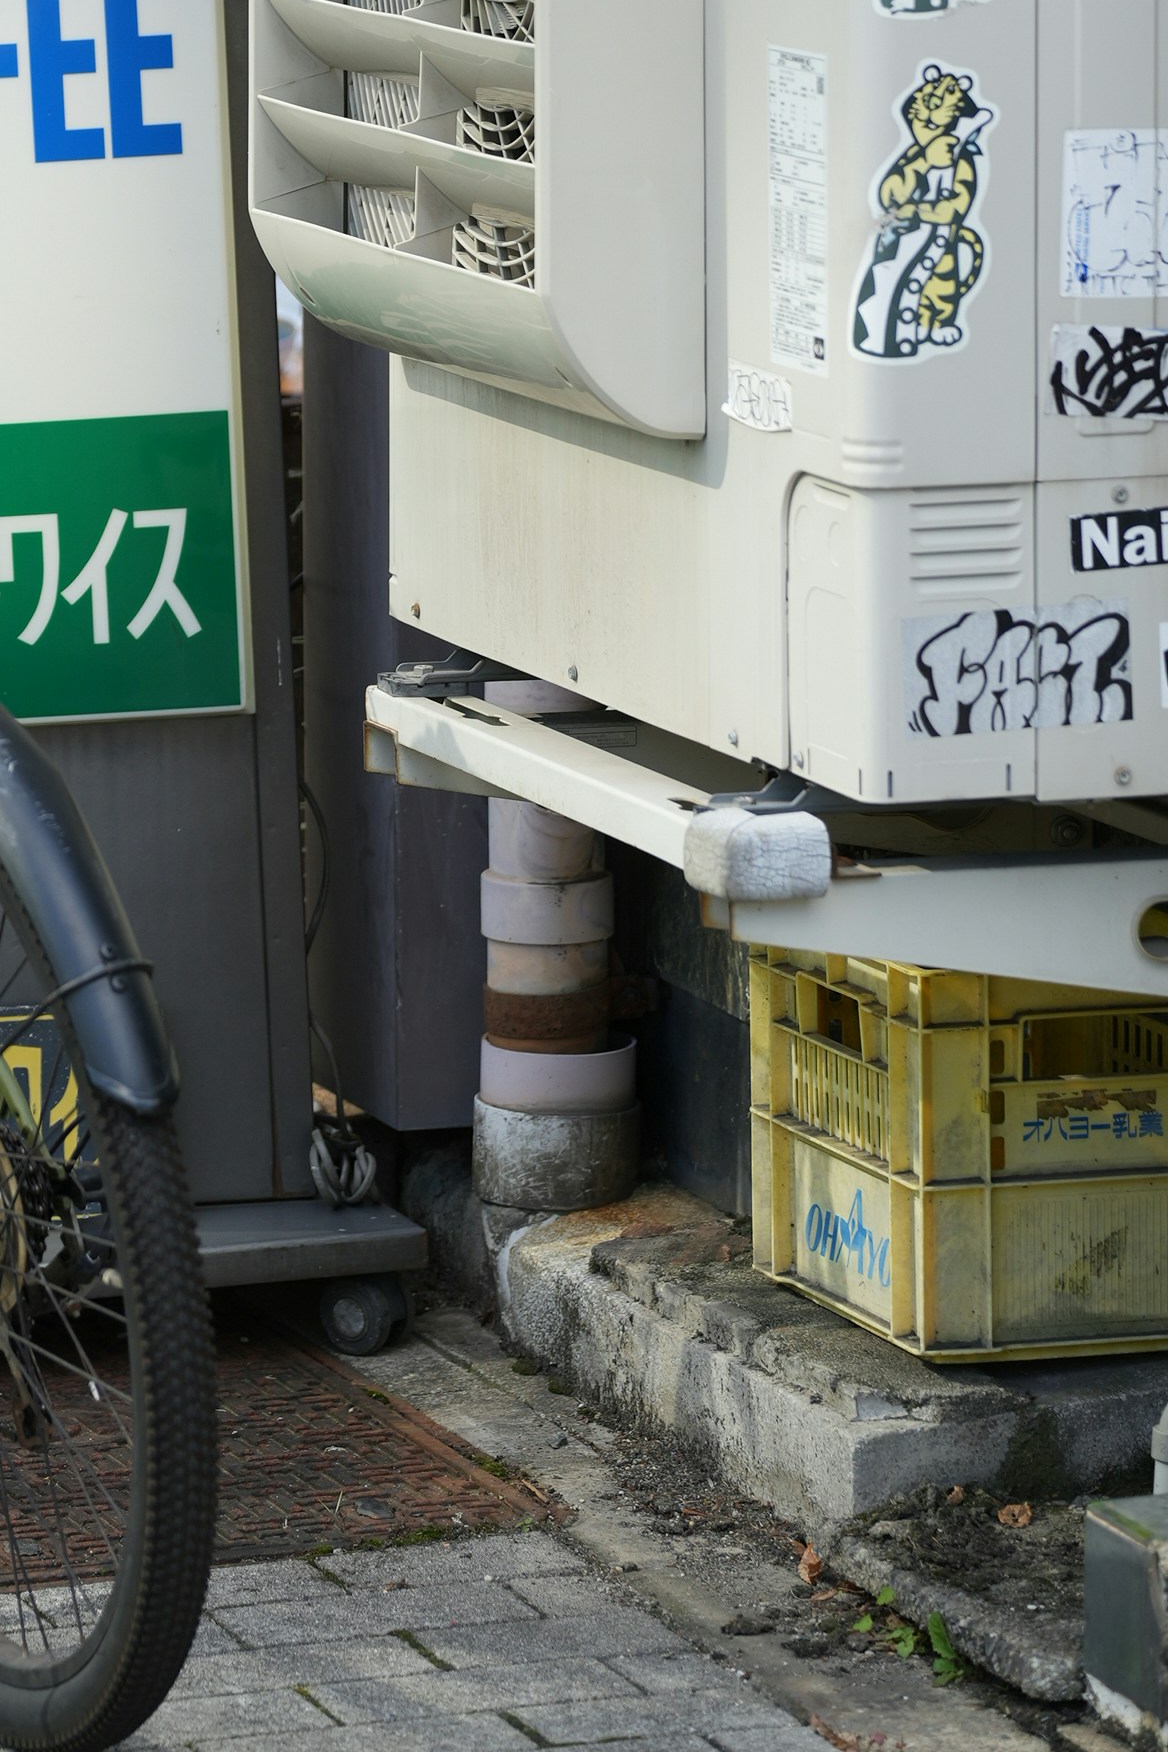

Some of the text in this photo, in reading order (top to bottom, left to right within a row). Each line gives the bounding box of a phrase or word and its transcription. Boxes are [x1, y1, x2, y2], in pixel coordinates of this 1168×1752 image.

[1023, 1111, 1164, 1143] オハヨー乳業
